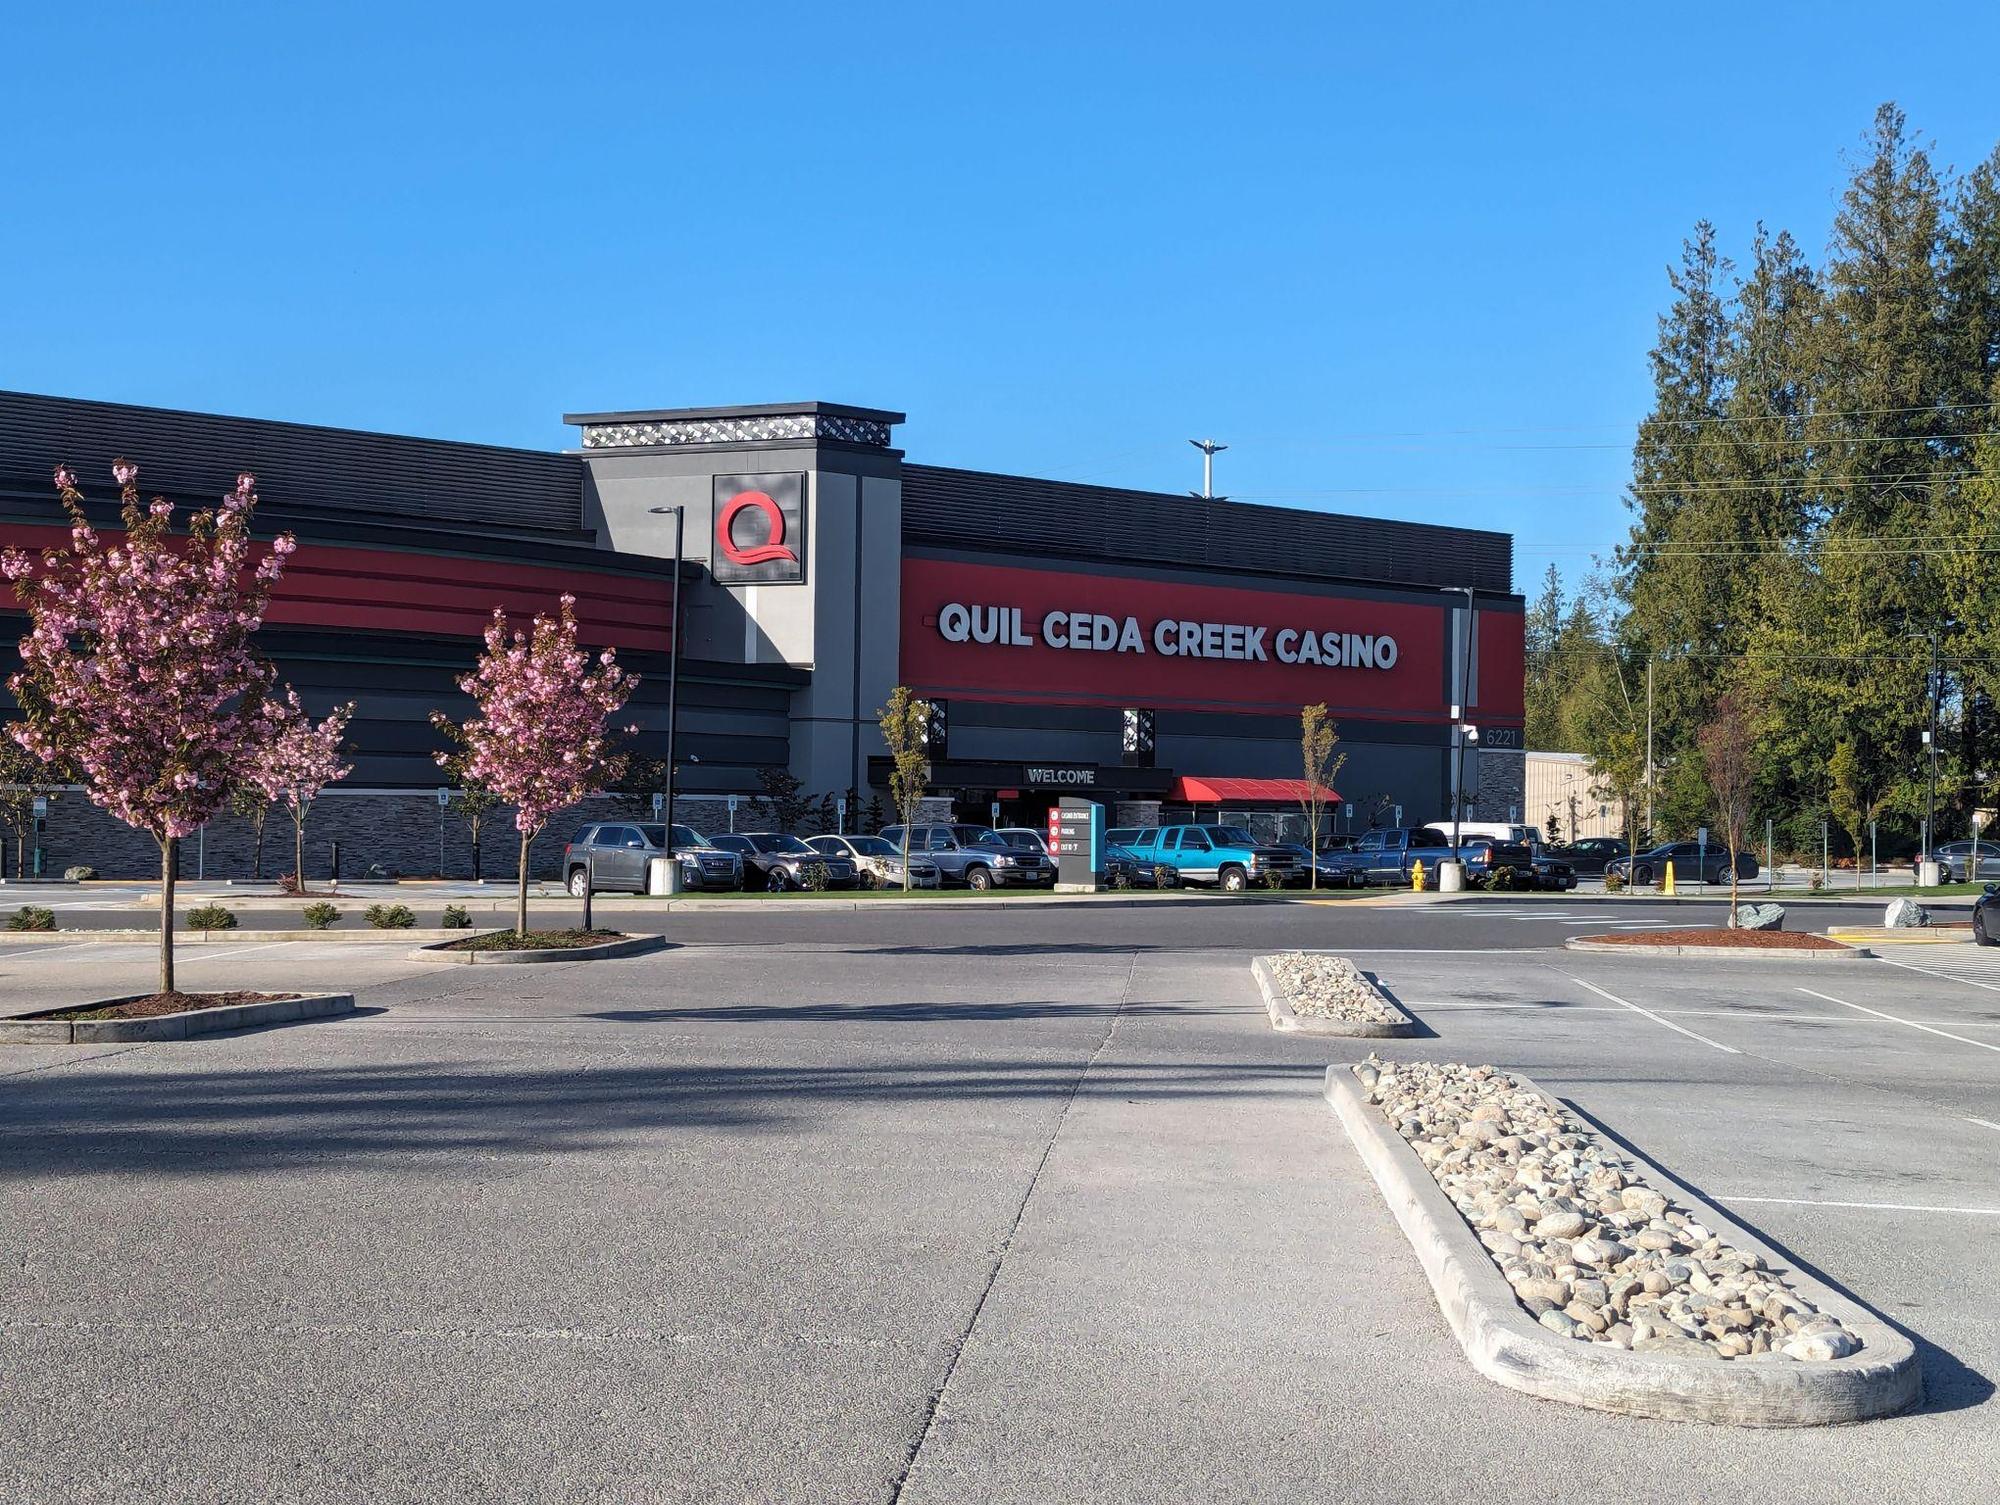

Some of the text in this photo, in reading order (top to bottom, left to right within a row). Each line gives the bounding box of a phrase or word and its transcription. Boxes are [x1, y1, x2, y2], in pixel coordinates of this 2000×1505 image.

[716, 490, 798, 566] Q
[939, 603, 1398, 670] QUIL CEDA CREEK CASINO
[1486, 729, 1516, 745] 6221
[1027, 768, 1095, 784] WELCOME
